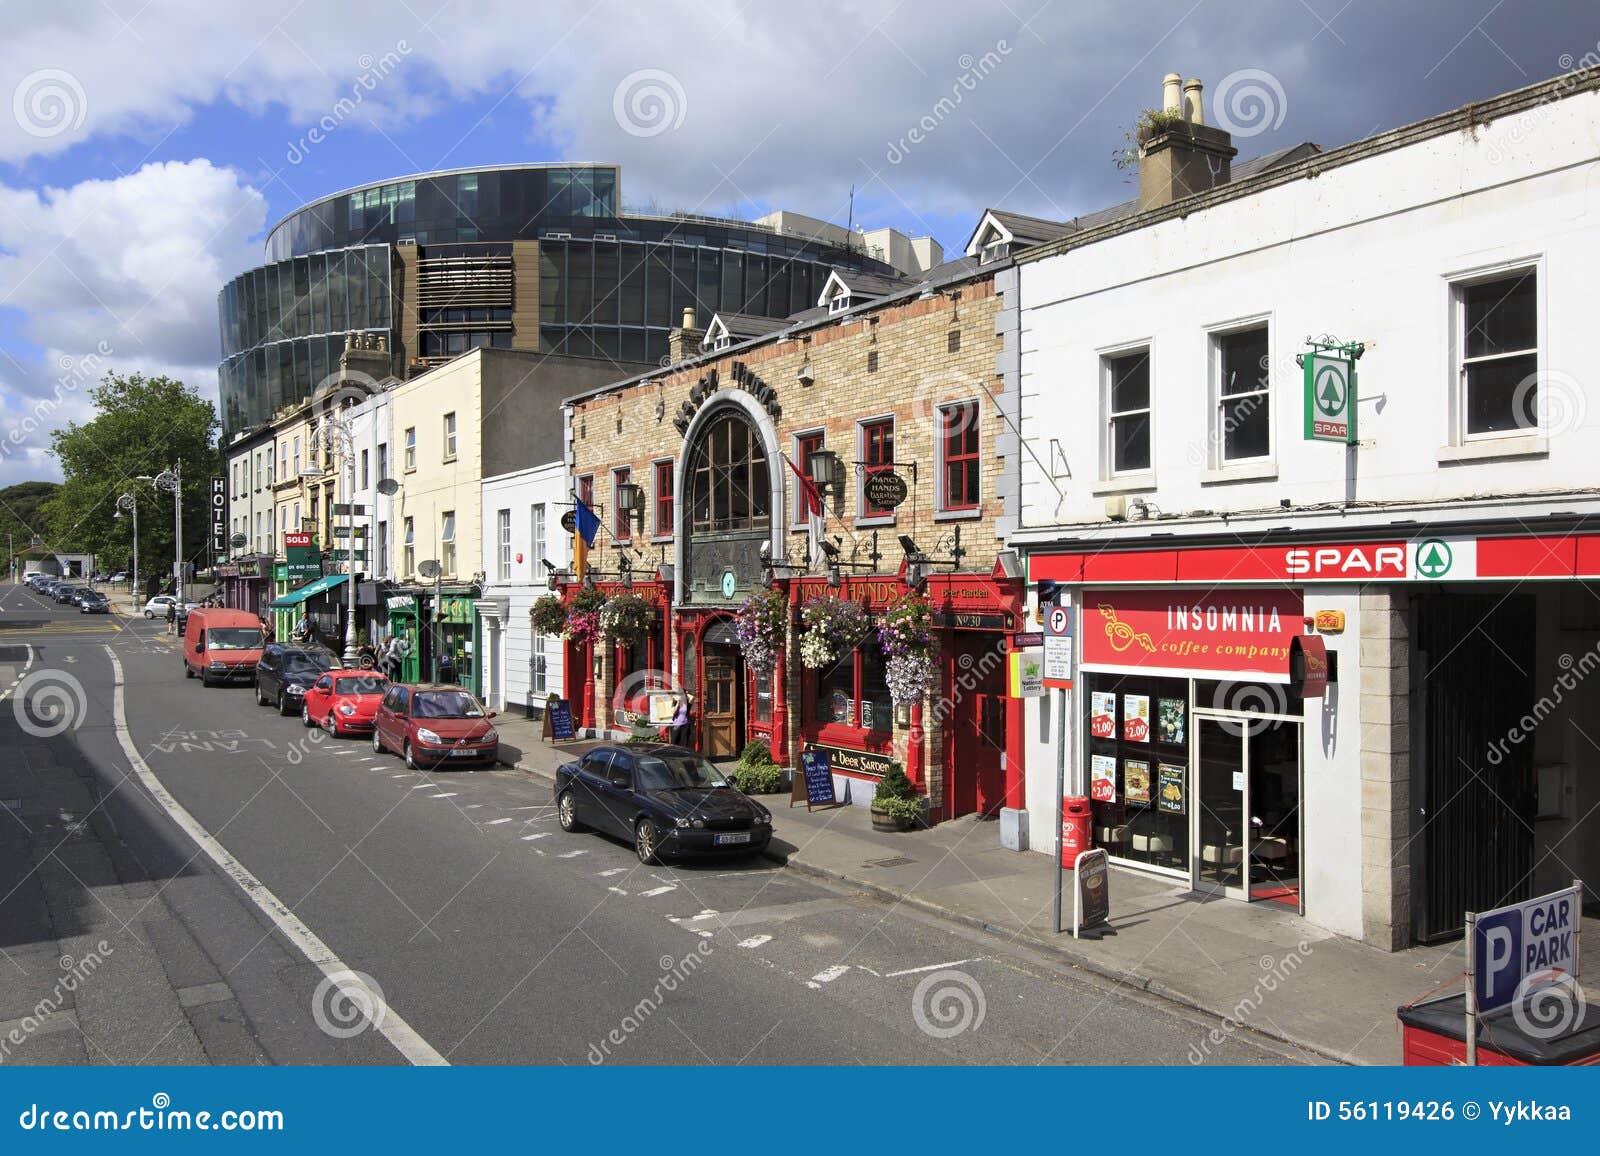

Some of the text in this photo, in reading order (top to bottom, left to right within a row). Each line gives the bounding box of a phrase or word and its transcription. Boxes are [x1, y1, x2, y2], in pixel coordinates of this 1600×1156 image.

[1314, 423, 1347, 435] SPAR
[213, 478, 224, 550] HOTEL
[286, 536, 309, 544] SOLD
[336, 528, 363, 536] SUBAY
[1286, 546, 1404, 574] SPAR
[848, 582, 898, 602] HANDS
[960, 588, 989, 598] Garden
[1040, 600, 1054, 609] ATM
[1168, 605, 1282, 633] INSOMNIA
[1161, 640, 1289, 661] coffee company
[1530, 900, 1570, 936] CAR
[1526, 931, 1572, 973] PARK
